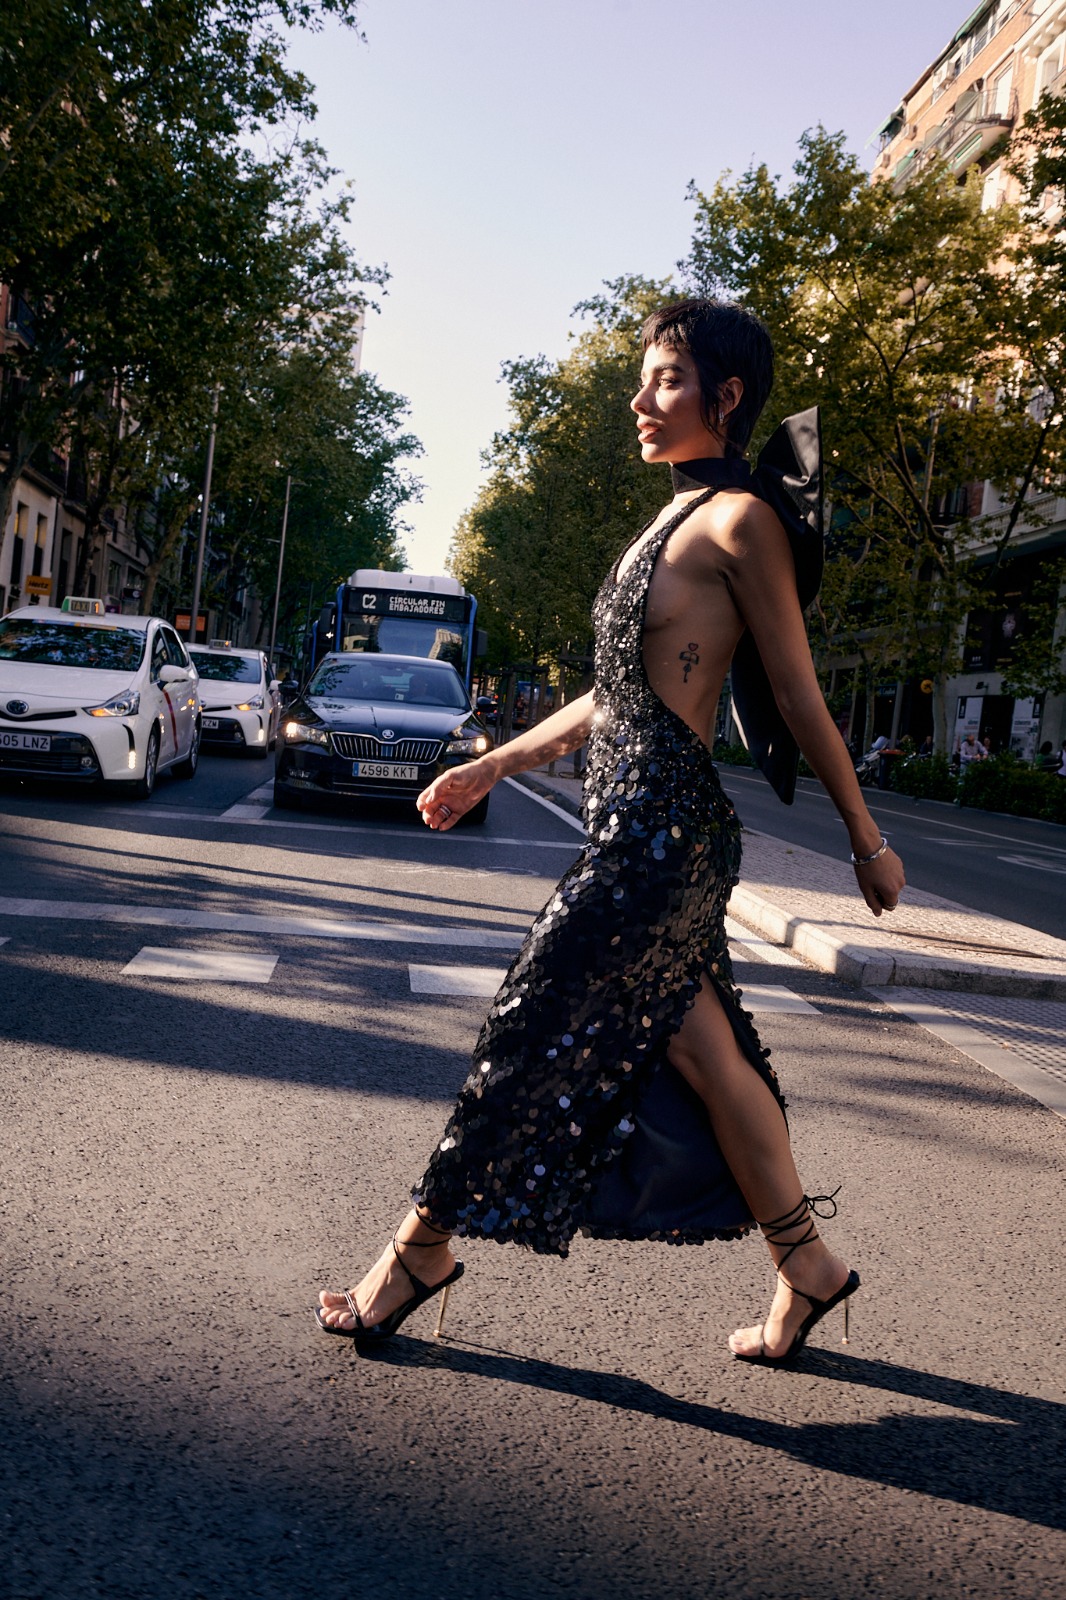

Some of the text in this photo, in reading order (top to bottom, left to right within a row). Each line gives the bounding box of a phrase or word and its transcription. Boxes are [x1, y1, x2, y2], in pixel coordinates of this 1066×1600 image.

[71, 601, 90, 612] TAXI
[94, 601, 99, 614] 1
[362, 594, 377, 609] C2
[389, 596, 446, 608] CIRCULAR FIN
[389, 603, 445, 615] EMBAJADORES
[0, 733, 48, 750] 05 LNZ
[360, 764, 415, 778] 4596 KKT
